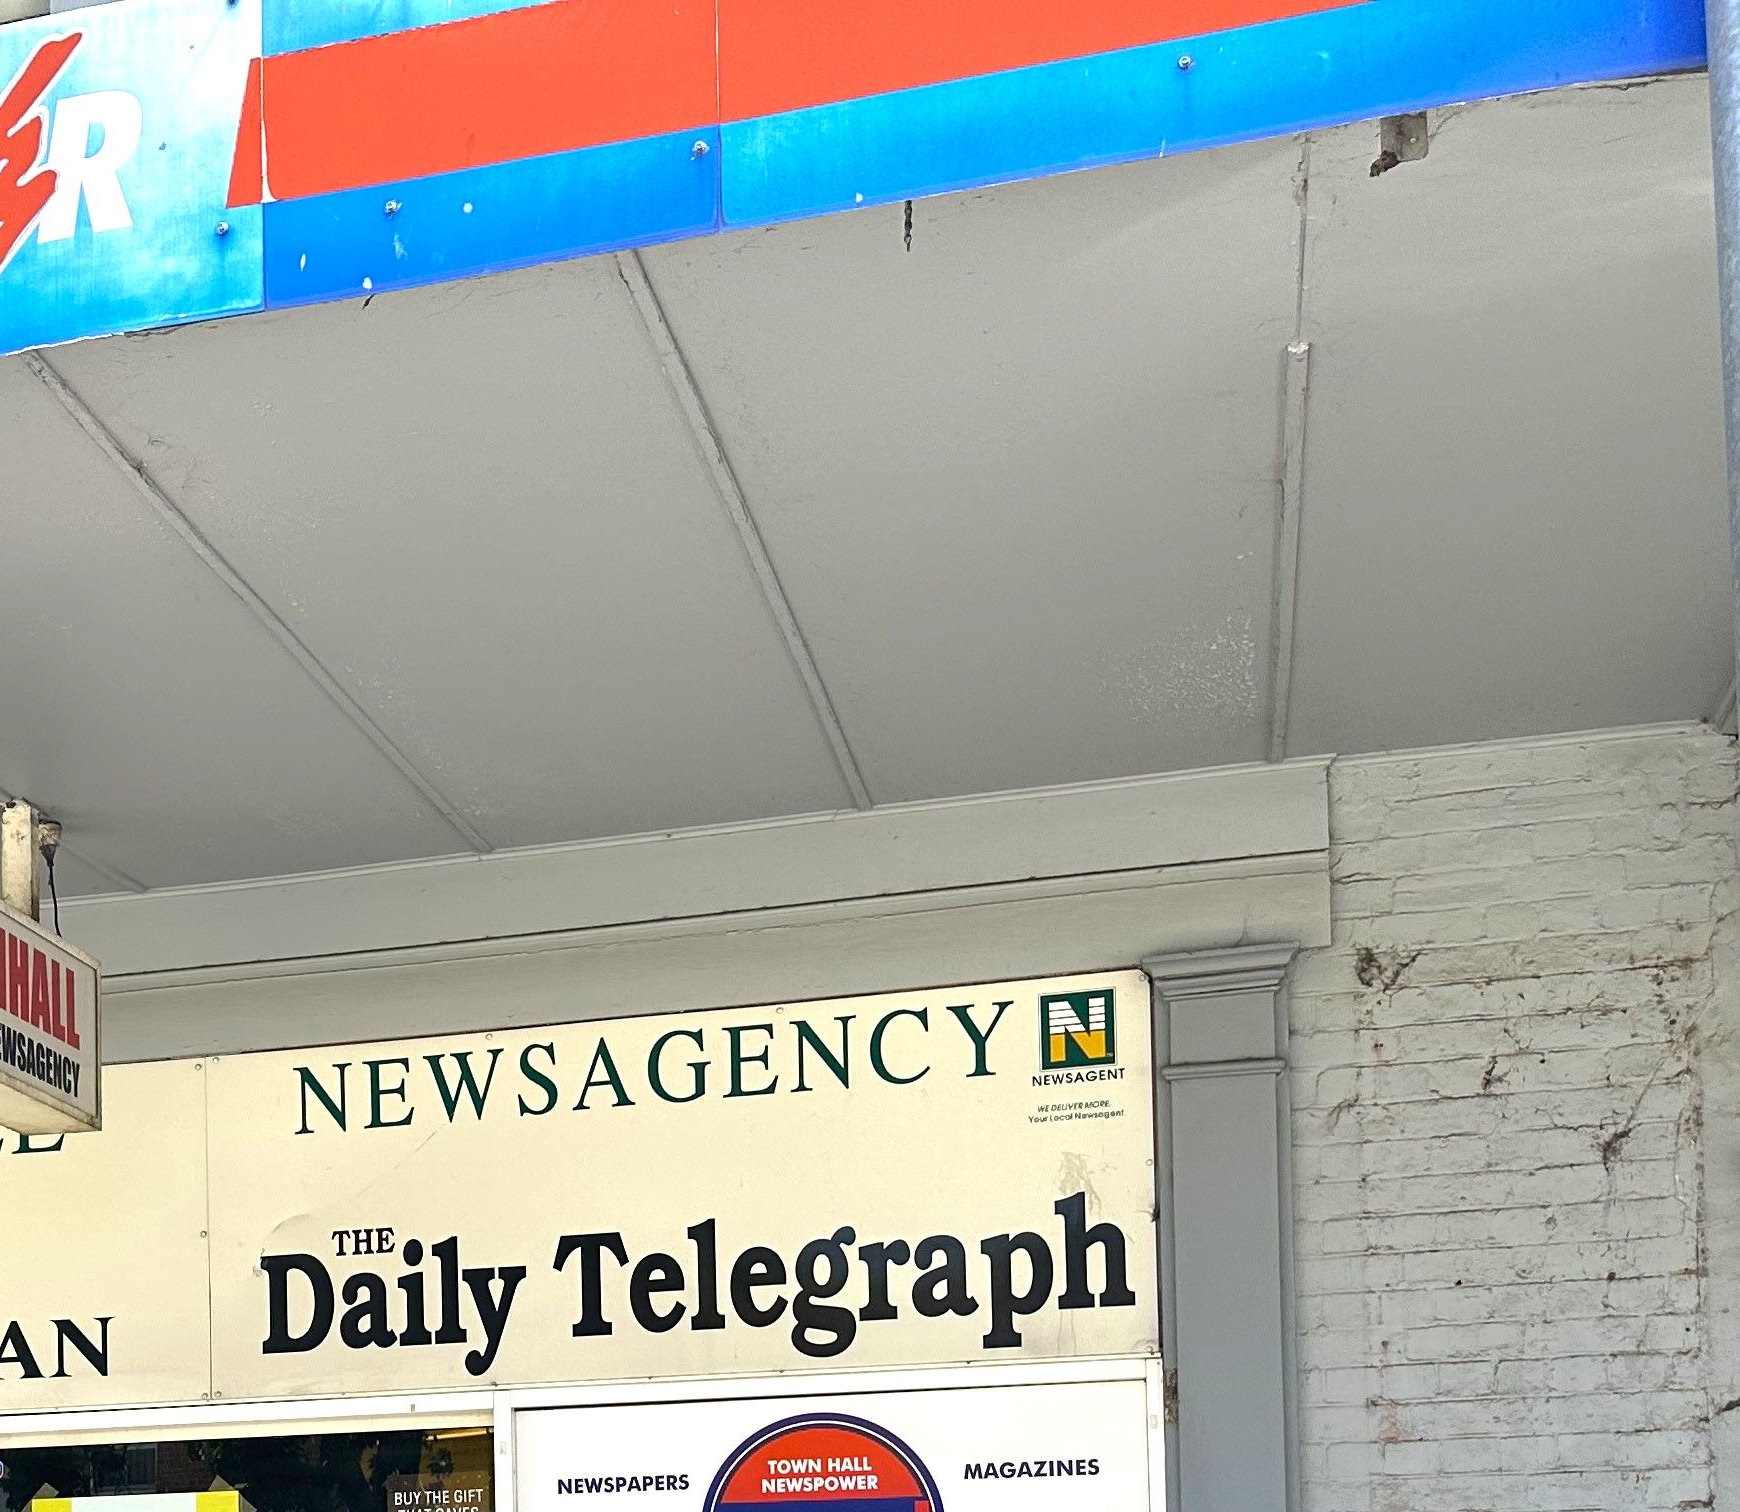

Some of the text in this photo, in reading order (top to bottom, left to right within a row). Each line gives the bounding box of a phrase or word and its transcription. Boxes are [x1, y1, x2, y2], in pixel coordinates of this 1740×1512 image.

[293, 1000, 1014, 1136] NEWSAGENCY
[1032, 1068, 1125, 1087] NEWSAGENT
[331, 1228, 396, 1257] THE
[260, 1192, 1136, 1377] Daily Telegraph
[767, 1456, 872, 1475] TOWN HALL
[964, 1458, 1101, 1481] MAGAZINES
[557, 1474, 690, 1496] NEWSPAPERS
[761, 1475, 879, 1494] NEWSPOWER
[394, 1488, 483, 1506] BUY THE GIFT
